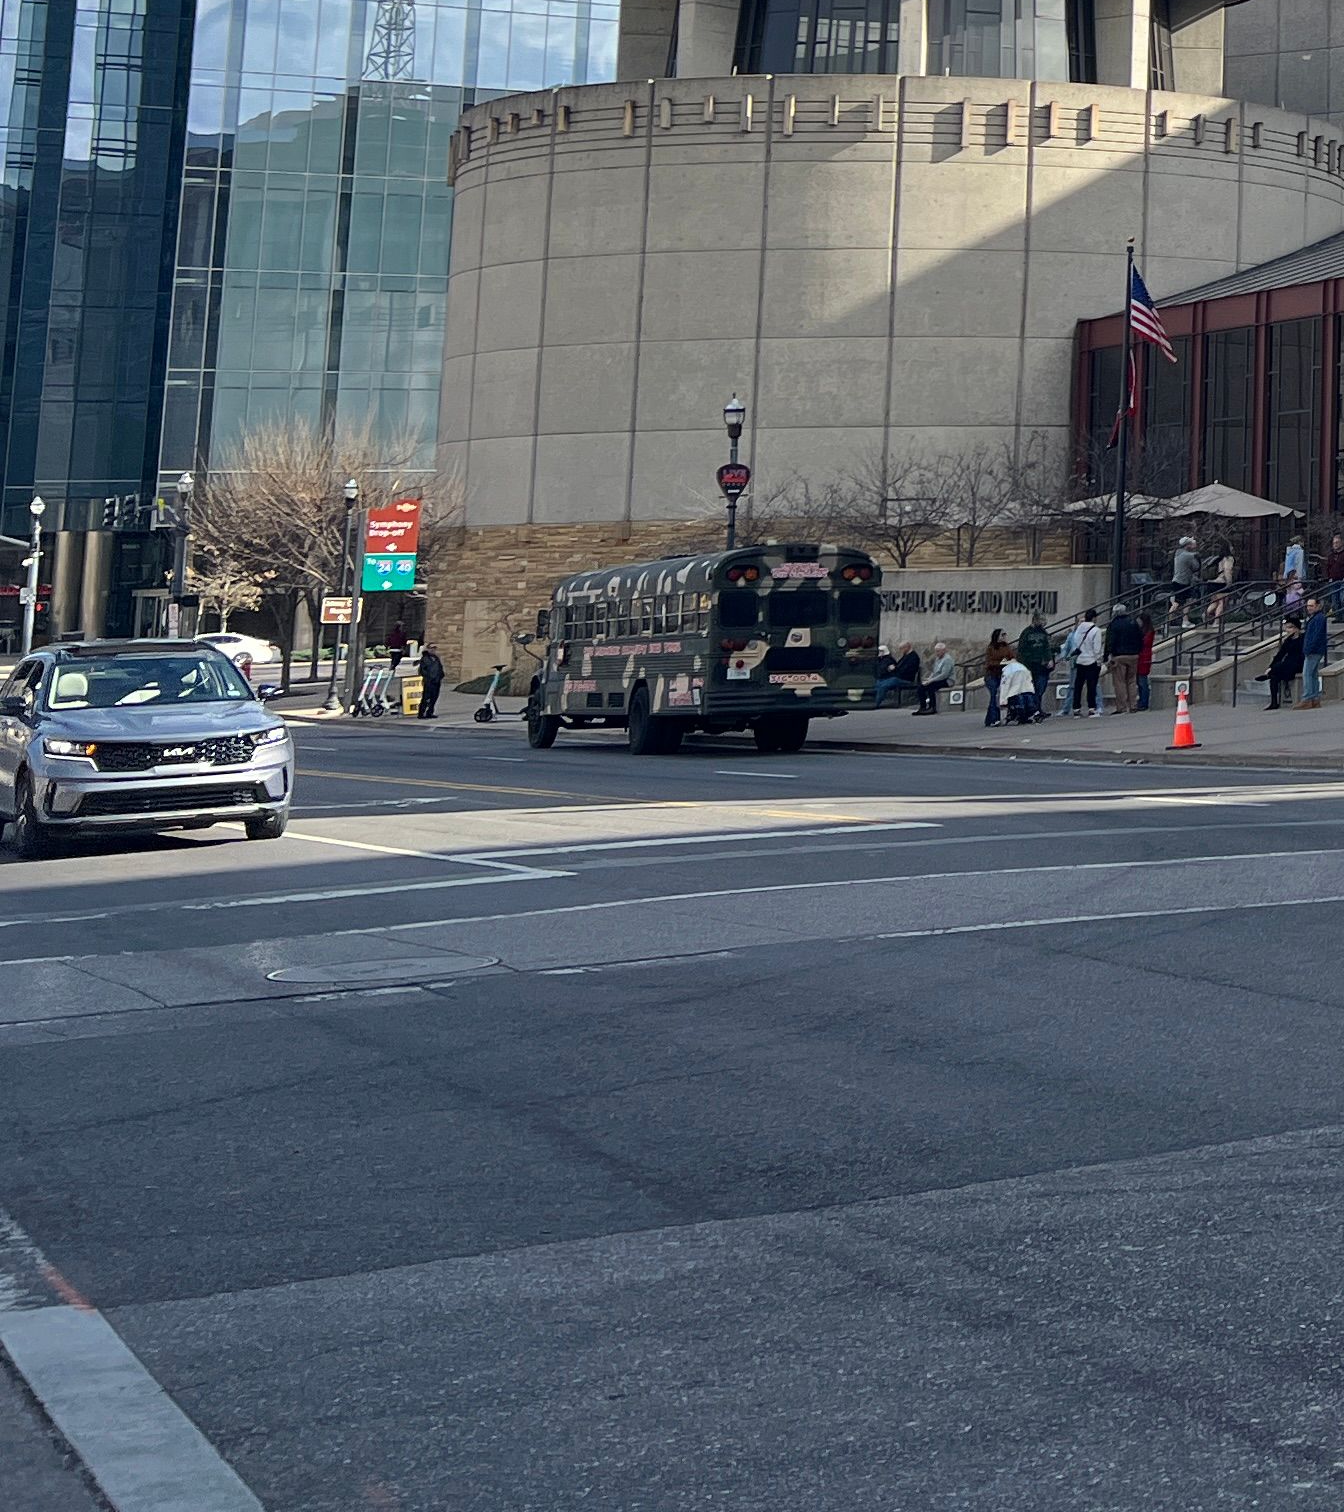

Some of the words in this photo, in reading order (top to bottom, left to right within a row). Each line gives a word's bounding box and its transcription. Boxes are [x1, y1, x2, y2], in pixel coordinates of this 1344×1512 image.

[369, 521, 413, 530] Symphony
[880, 591, 900, 612] SIC
[901, 591, 927, 612] HALL
[928, 591, 945, 612] OF
[946, 591, 977, 613] FAME
[977, 591, 1002, 613] AND
[1004, 591, 1058, 614] MUSEUM
